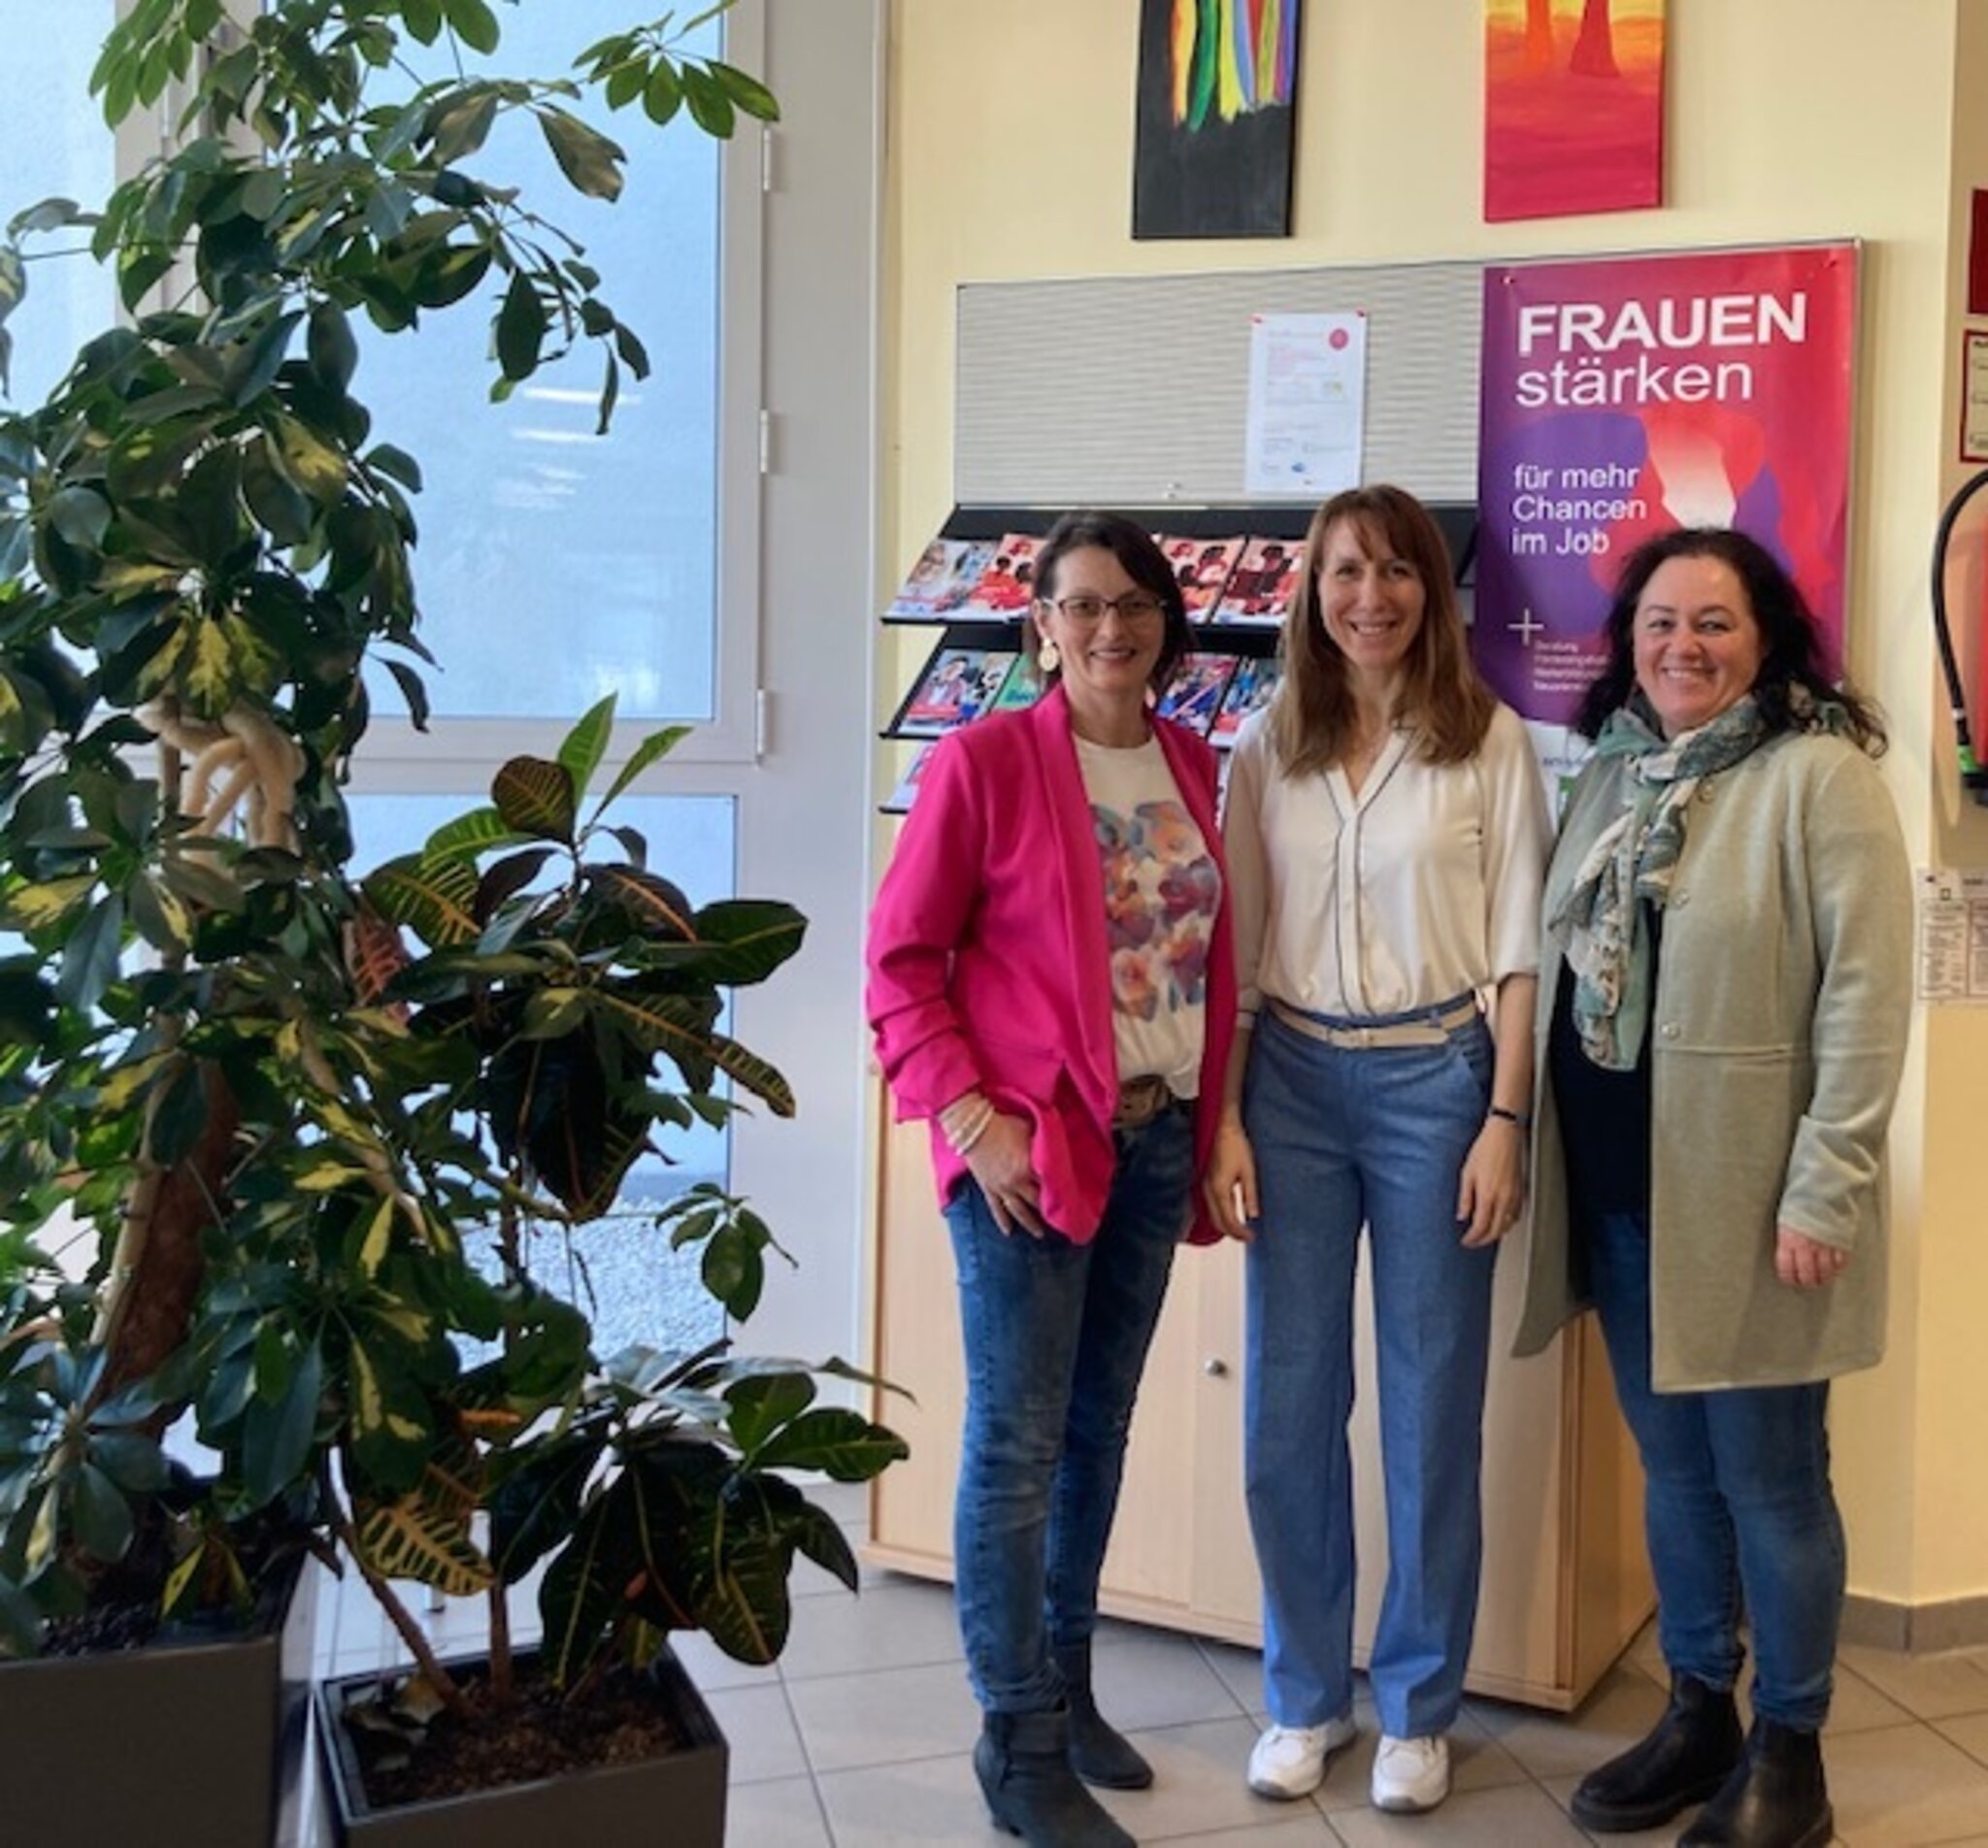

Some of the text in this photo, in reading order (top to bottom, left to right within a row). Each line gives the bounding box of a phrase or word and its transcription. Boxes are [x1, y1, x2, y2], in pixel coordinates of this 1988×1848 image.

[1517, 292, 1807, 356] FRAUEN
[1515, 355, 1753, 408] stärken
[1512, 464, 1640, 489] für mehr
[1511, 496, 1647, 520] Chancen
[1511, 527, 1611, 555] im Job
